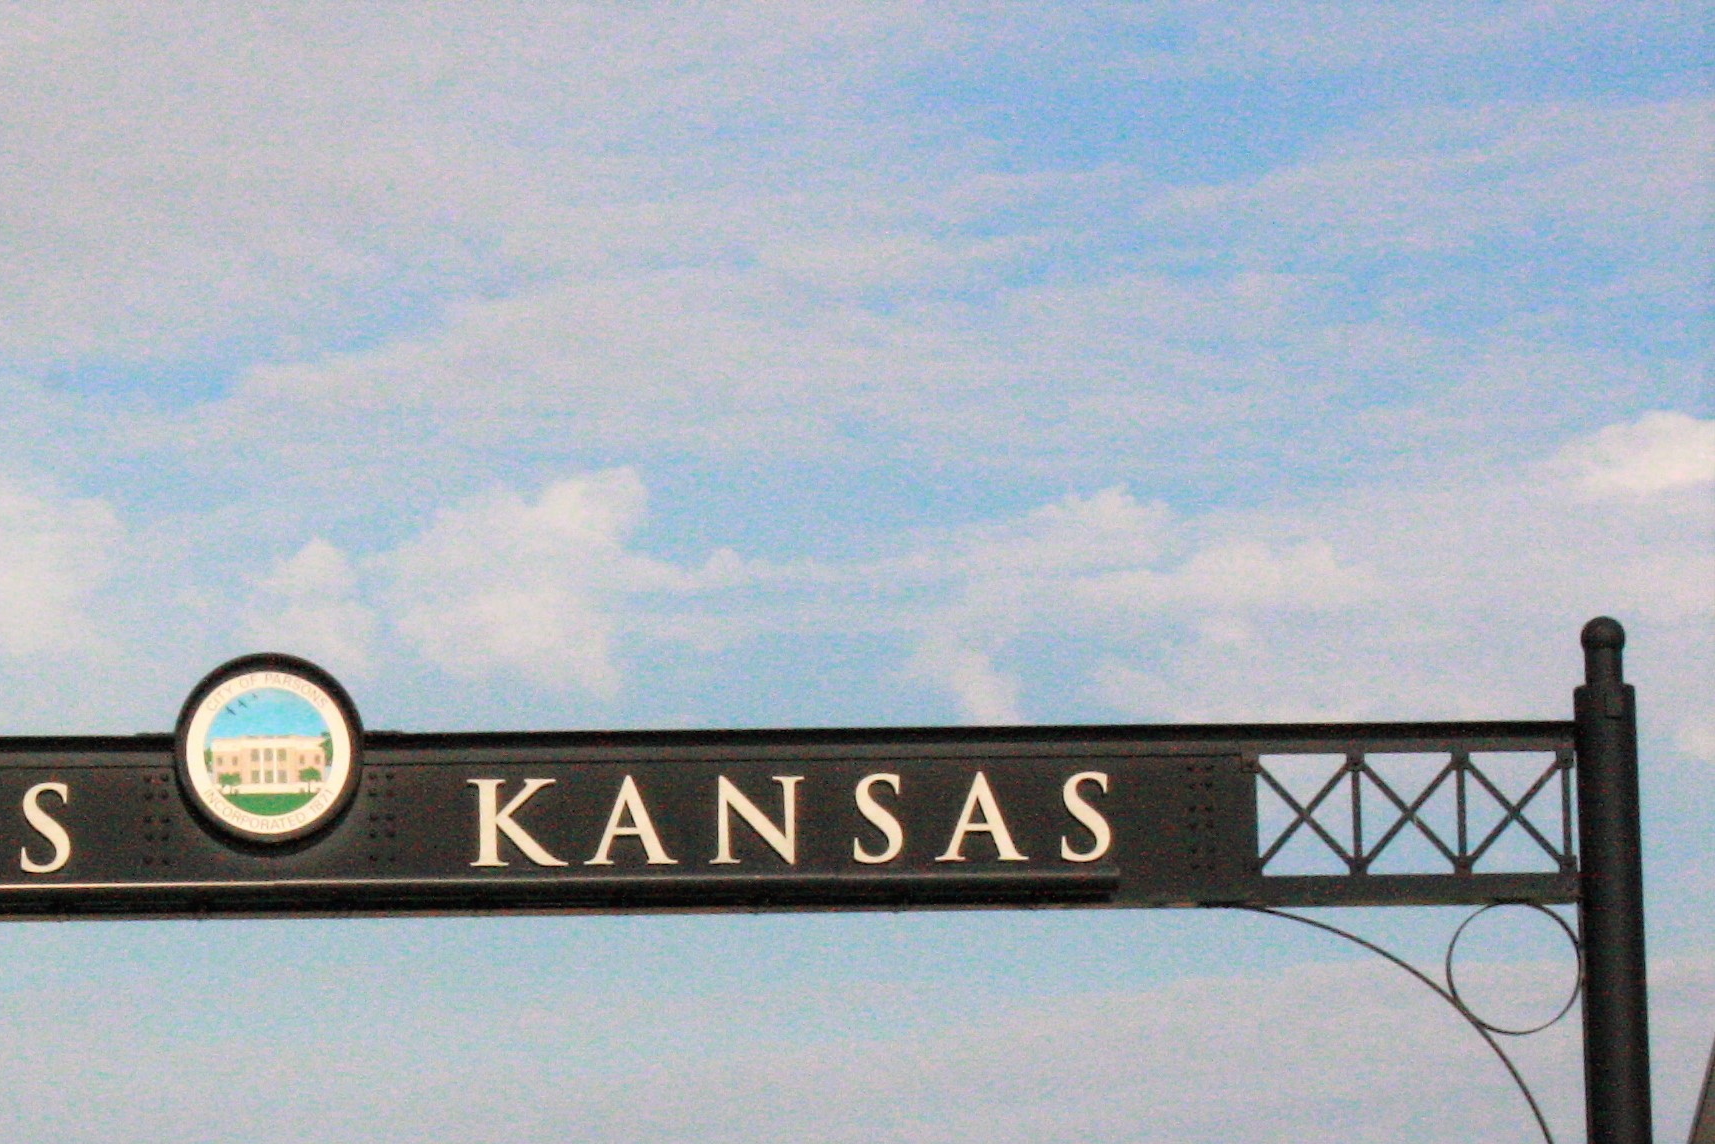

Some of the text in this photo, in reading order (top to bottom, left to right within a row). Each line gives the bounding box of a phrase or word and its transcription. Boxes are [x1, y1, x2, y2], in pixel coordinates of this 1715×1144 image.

[206, 674, 330, 713] CITY OF PARSONS
[204, 787, 336, 831] INCORPORATED 1871
[467, 770, 1113, 868] KANSAS
